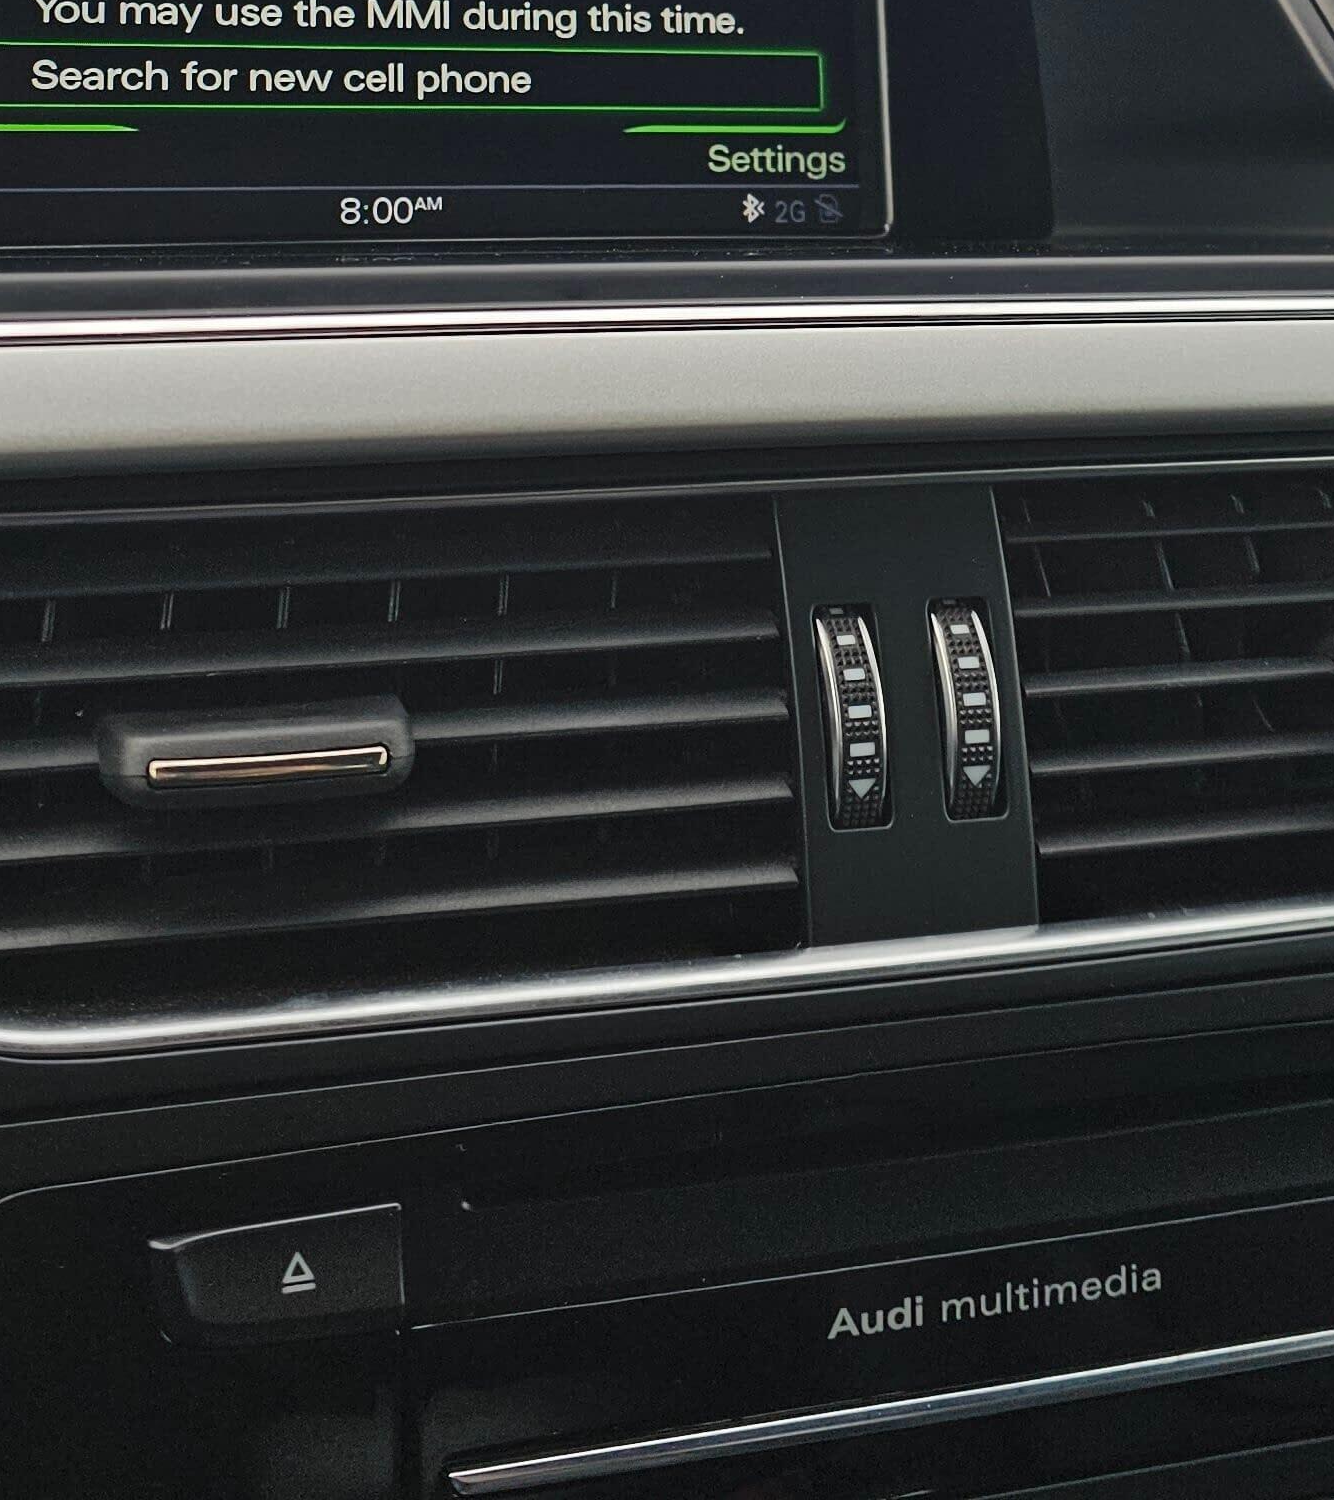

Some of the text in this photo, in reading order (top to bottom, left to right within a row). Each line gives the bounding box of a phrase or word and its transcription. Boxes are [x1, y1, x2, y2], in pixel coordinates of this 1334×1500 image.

[119, 1, 204, 34] may
[215, 3, 283, 27] use
[462, 0, 577, 39] during
[586, 3, 652, 33] this
[660, 4, 744, 35] time.
[31, 59, 532, 101] Search for new cell phone
[708, 143, 846, 180] Settings
[775, 199, 806, 223] 2G
[827, 1263, 1162, 1340] Audi multimedia
